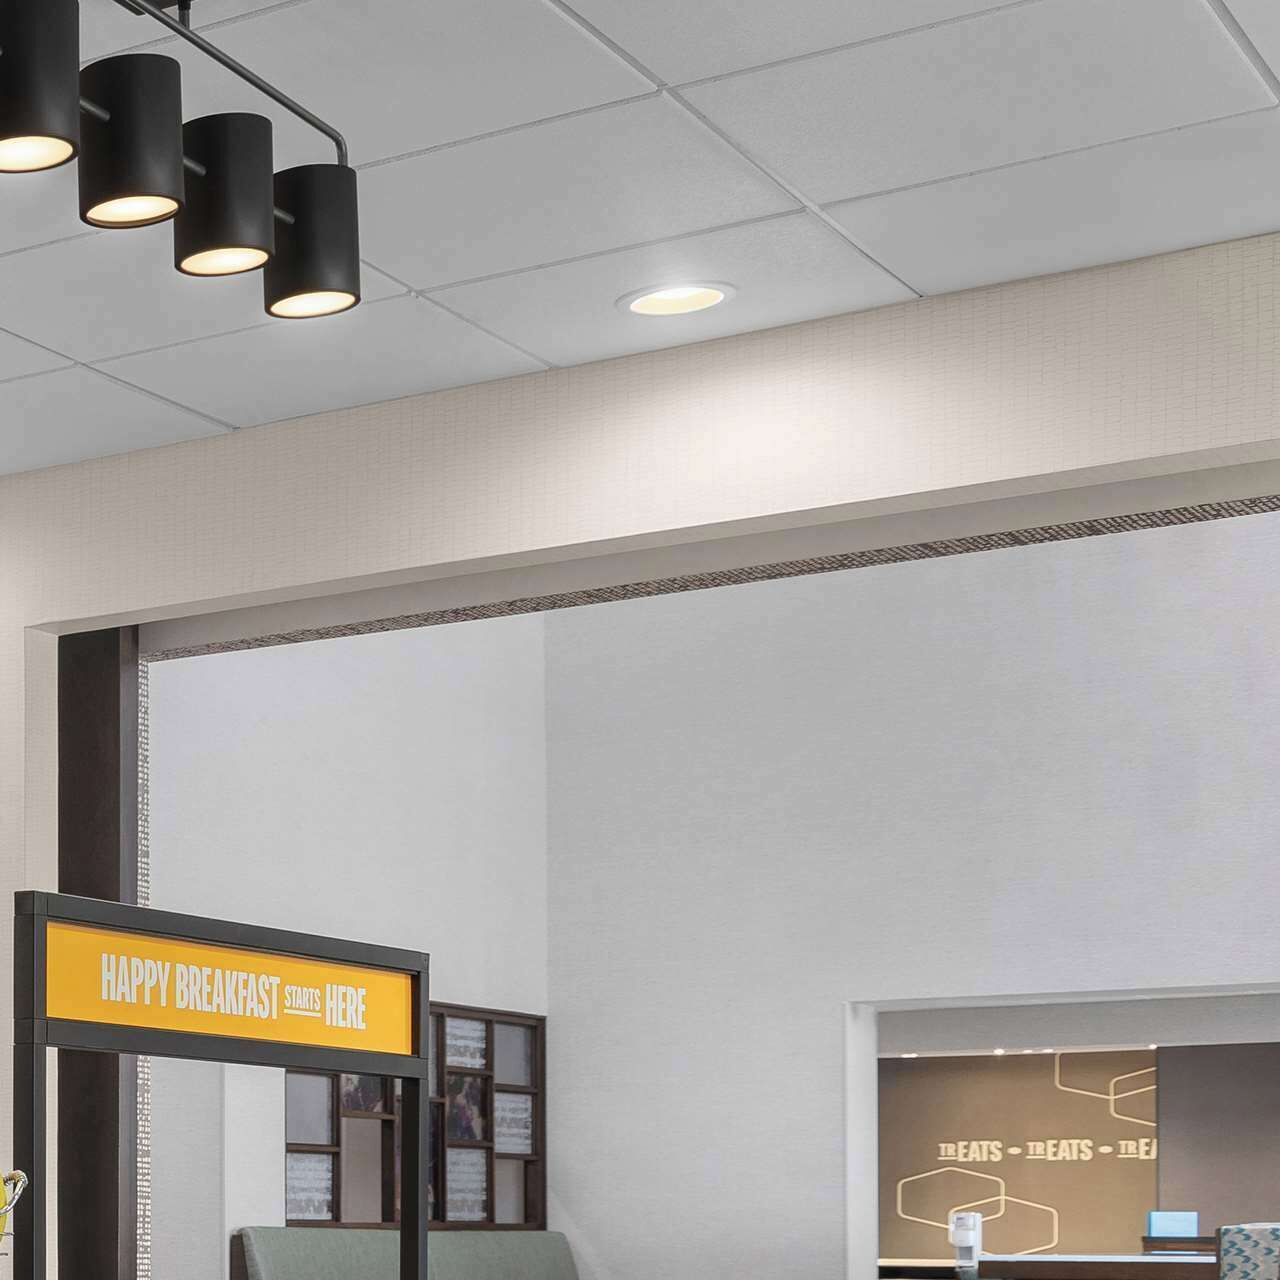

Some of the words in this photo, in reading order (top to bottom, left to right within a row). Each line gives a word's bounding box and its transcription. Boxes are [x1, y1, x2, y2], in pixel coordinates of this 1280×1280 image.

[101, 953, 171, 1008] HAPPY
[175, 963, 281, 1020] BREAKFAST
[283, 984, 322, 1011] STARTS
[325, 983, 367, 1031] HERE
